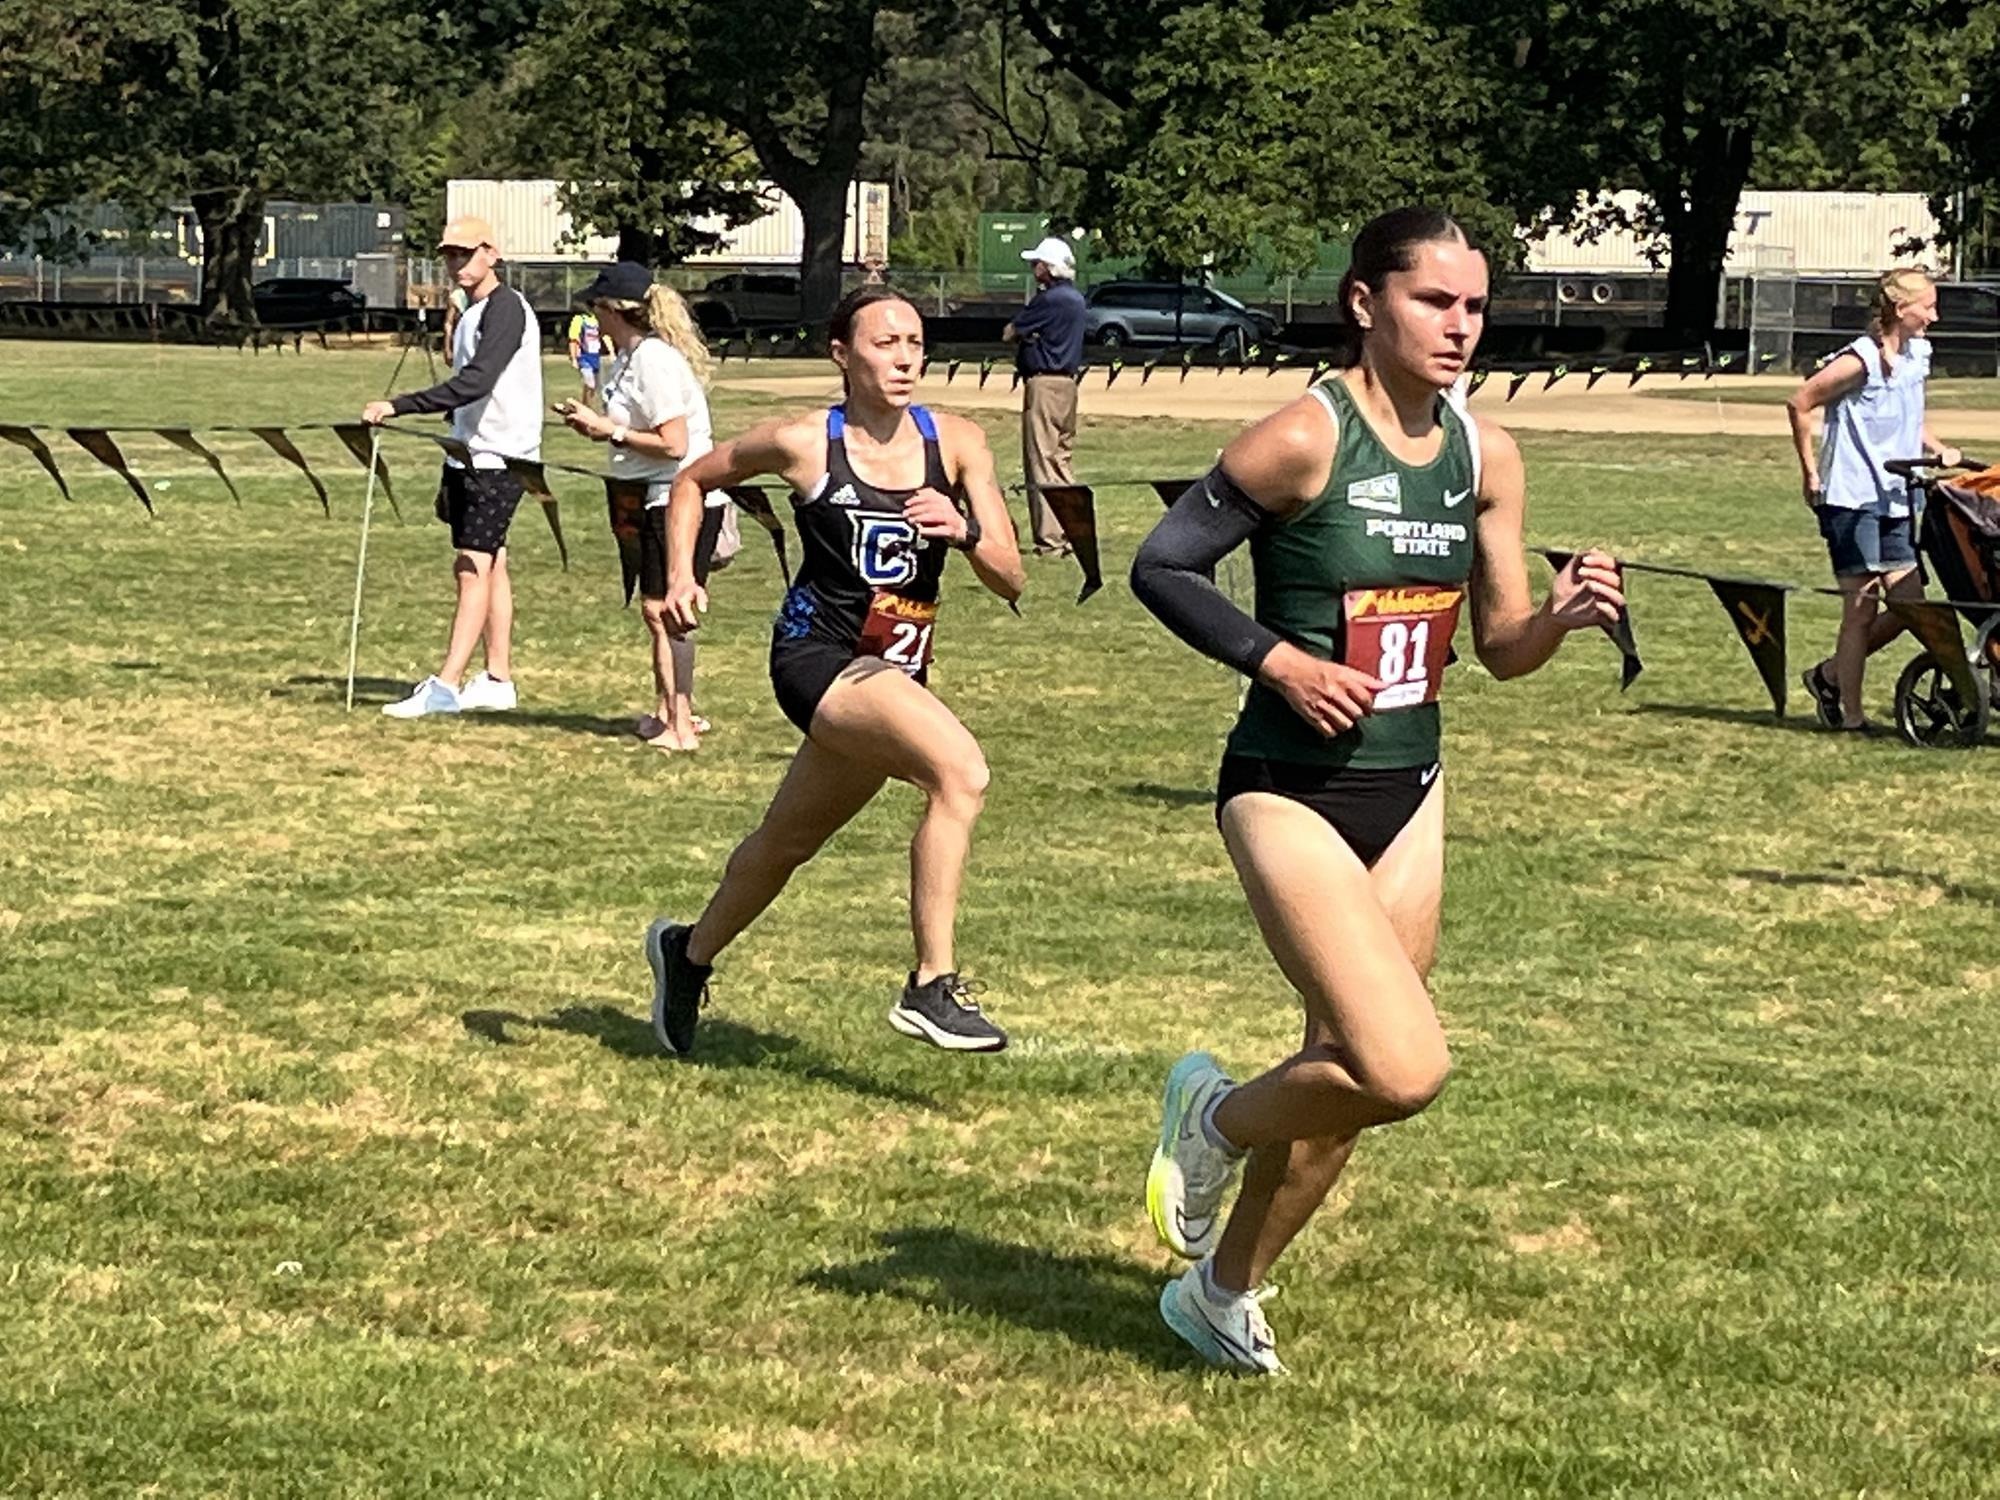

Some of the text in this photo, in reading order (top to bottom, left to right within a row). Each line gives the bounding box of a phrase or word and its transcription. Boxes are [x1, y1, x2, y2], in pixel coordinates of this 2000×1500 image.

[855, 512, 918, 586] C
[1365, 518, 1467, 542] PORTLAND
[1392, 536, 1451, 556] STATE
[883, 622, 932, 666] 21
[1379, 620, 1428, 684] 81
